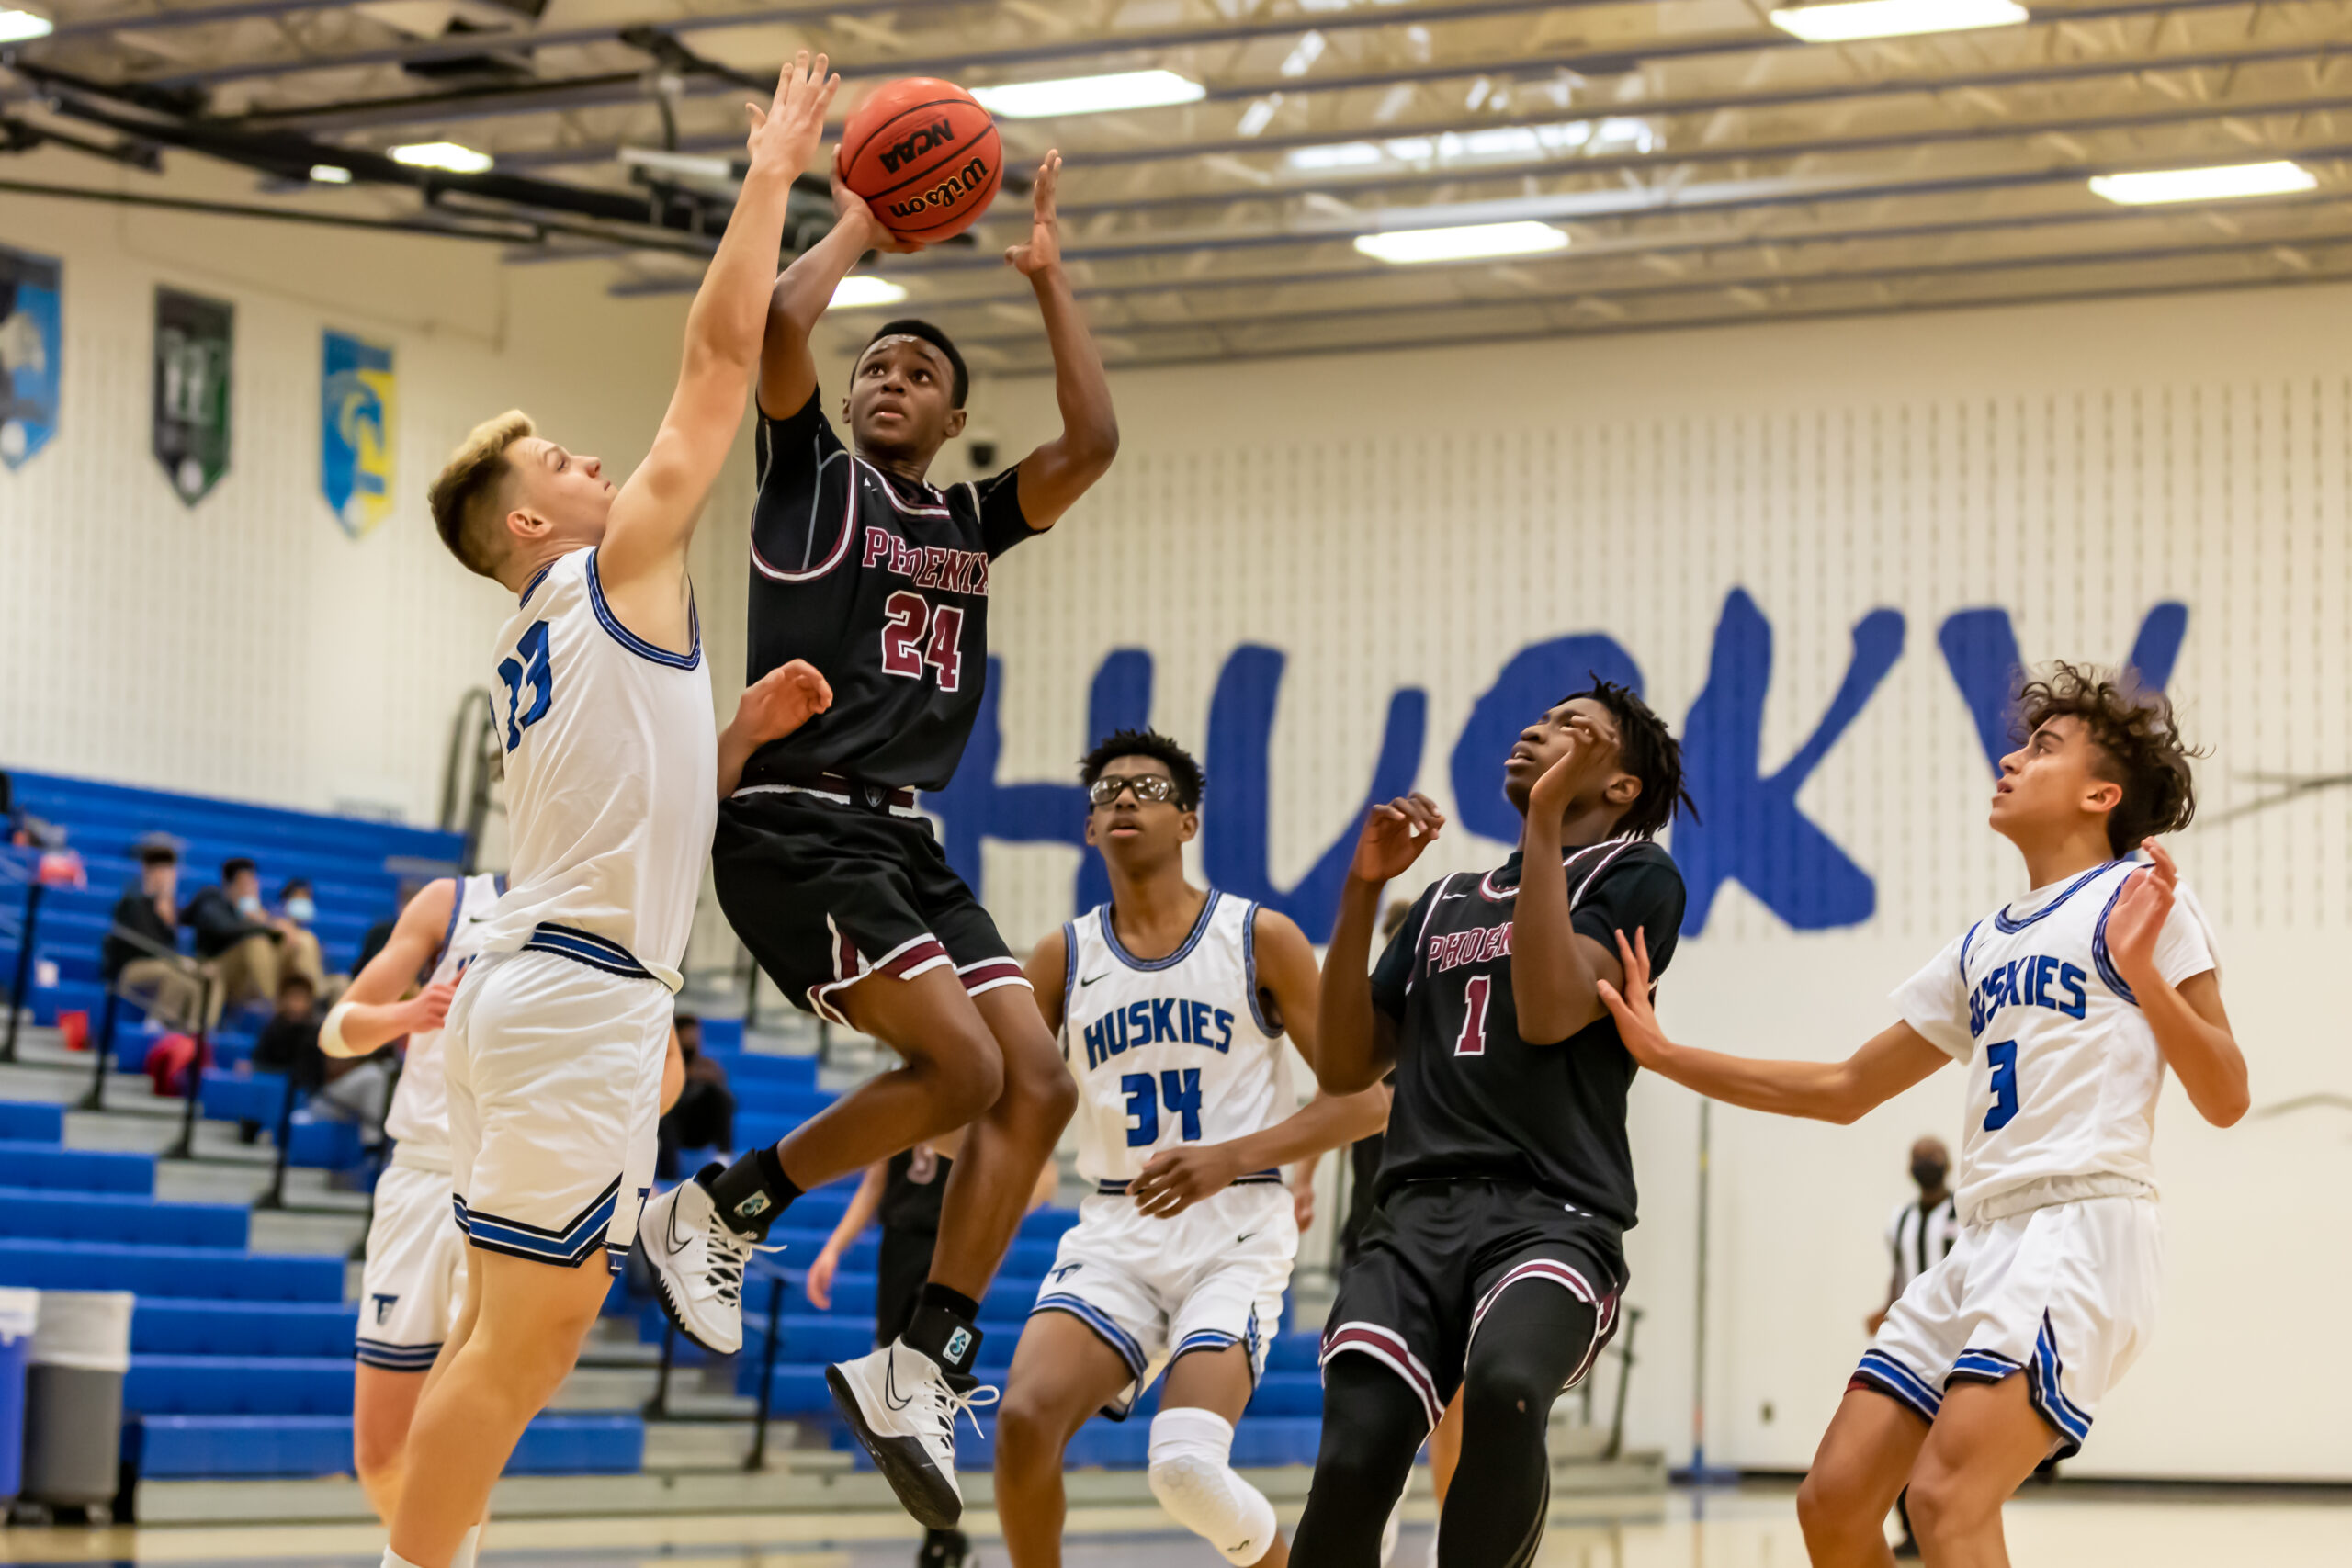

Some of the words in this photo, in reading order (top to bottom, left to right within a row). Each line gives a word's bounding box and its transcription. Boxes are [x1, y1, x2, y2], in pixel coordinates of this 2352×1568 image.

[879, 118, 955, 174] NCAA
[889, 157, 989, 217] Wilson
[881, 590, 964, 692] 24
[1425, 921, 1515, 978] PHOEN
[1083, 998, 1235, 1072] HUSKIES
[1454, 974, 1491, 1056] 1
[1121, 1068, 1203, 1147] 34
[1984, 1039, 2019, 1133] 3
